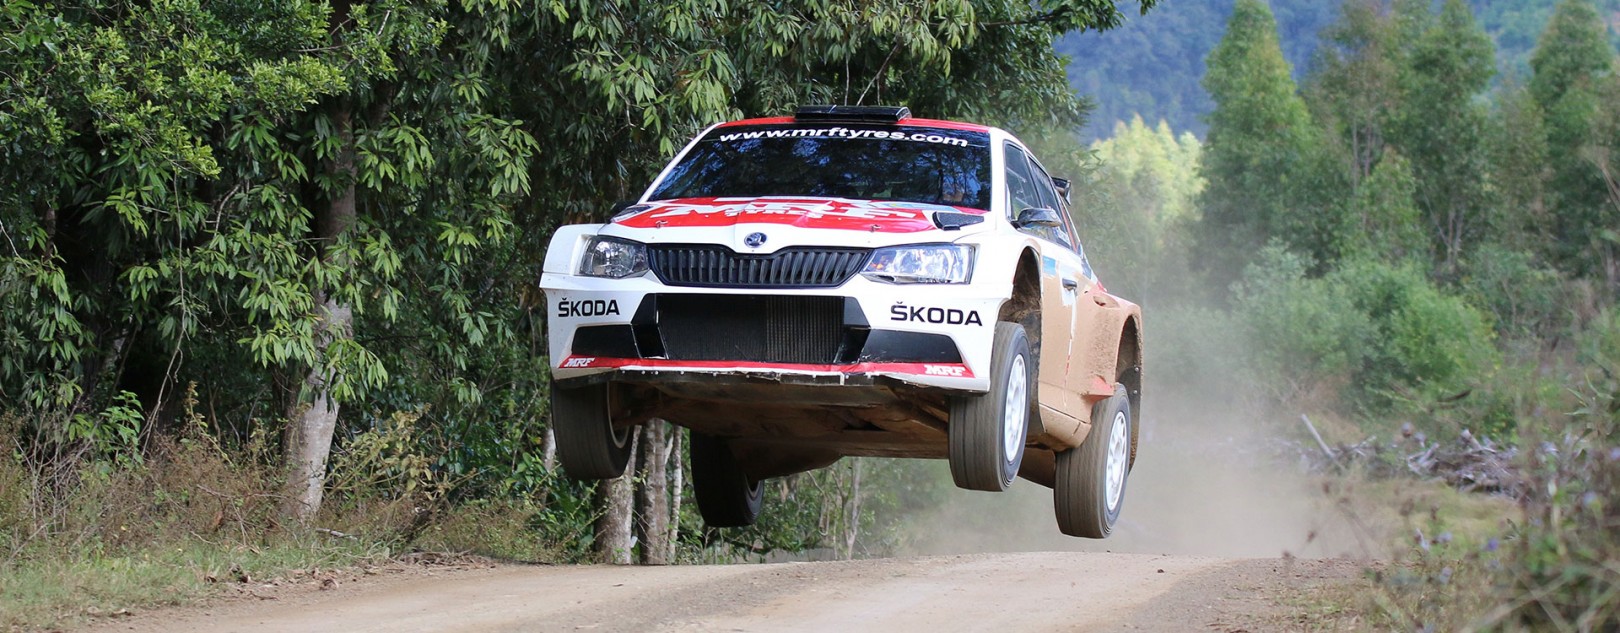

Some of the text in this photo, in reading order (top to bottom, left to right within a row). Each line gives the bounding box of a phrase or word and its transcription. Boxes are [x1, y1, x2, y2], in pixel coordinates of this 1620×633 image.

[720, 127, 968, 147] www.mrftyres.com
[558, 298, 620, 317] ŠKODA
[890, 301, 983, 327] ŠKODA
[564, 357, 596, 368] MRF
[923, 364, 966, 377] MRF
